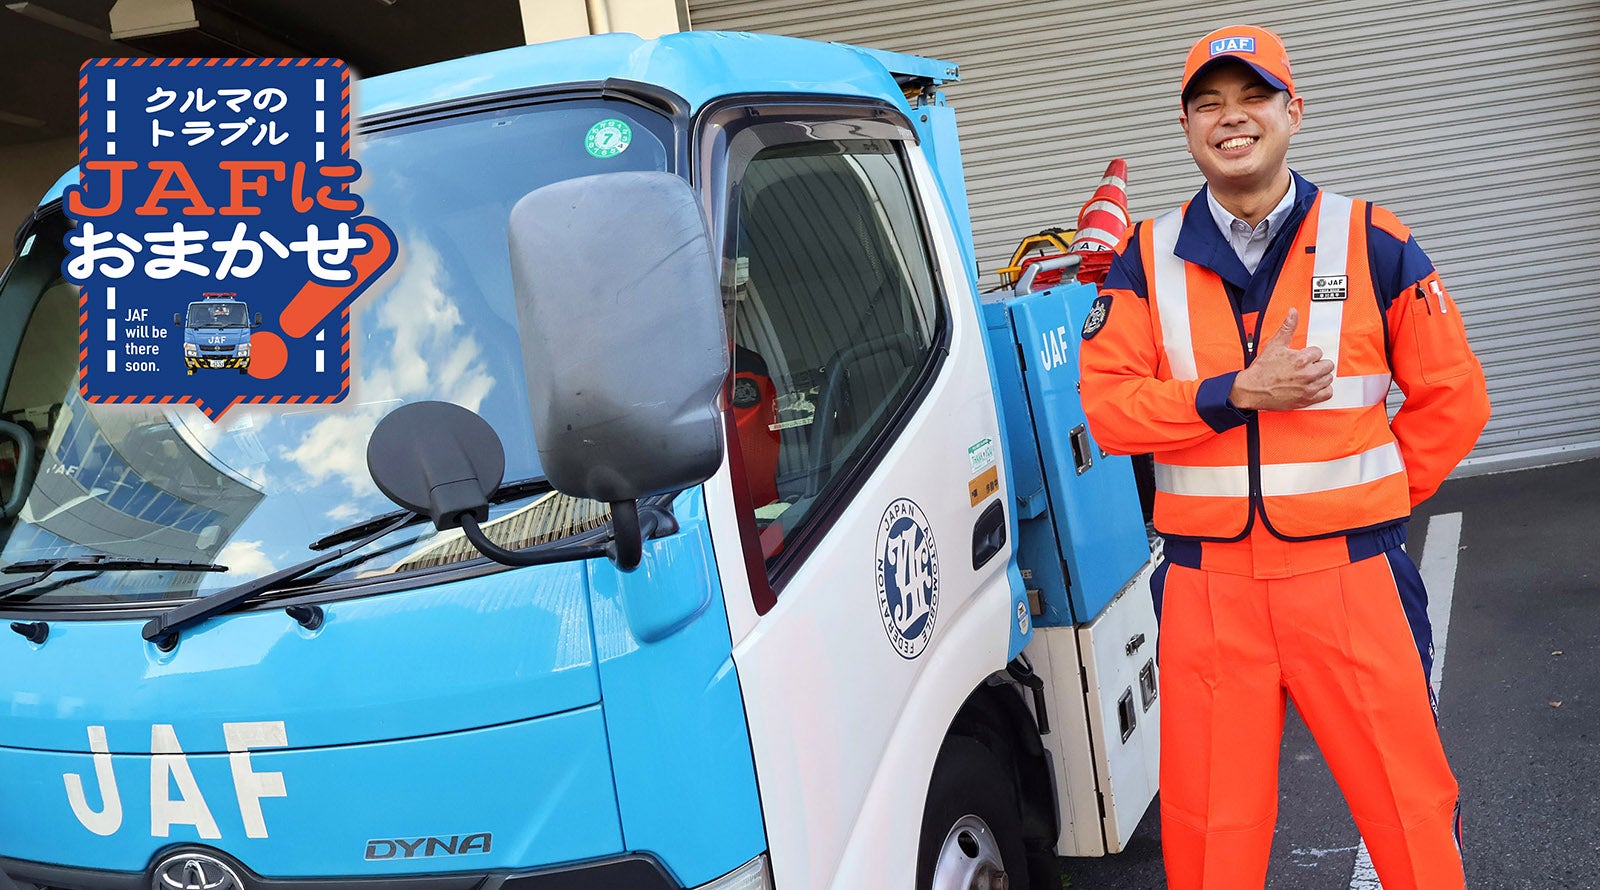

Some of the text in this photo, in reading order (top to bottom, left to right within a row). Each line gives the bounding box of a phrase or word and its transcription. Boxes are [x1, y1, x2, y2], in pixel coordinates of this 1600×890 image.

[1215, 39, 1248, 51] JAF
[603, 133, 613, 145] 7
[1041, 327, 1067, 371] JAF
[884, 503, 915, 532] JAPAN
[921, 526, 938, 643] AUTOMOBILE
[877, 558, 915, 655] FEDERATION
[63, 721, 288, 839] JAF
[365, 833, 492, 860] DYNA
